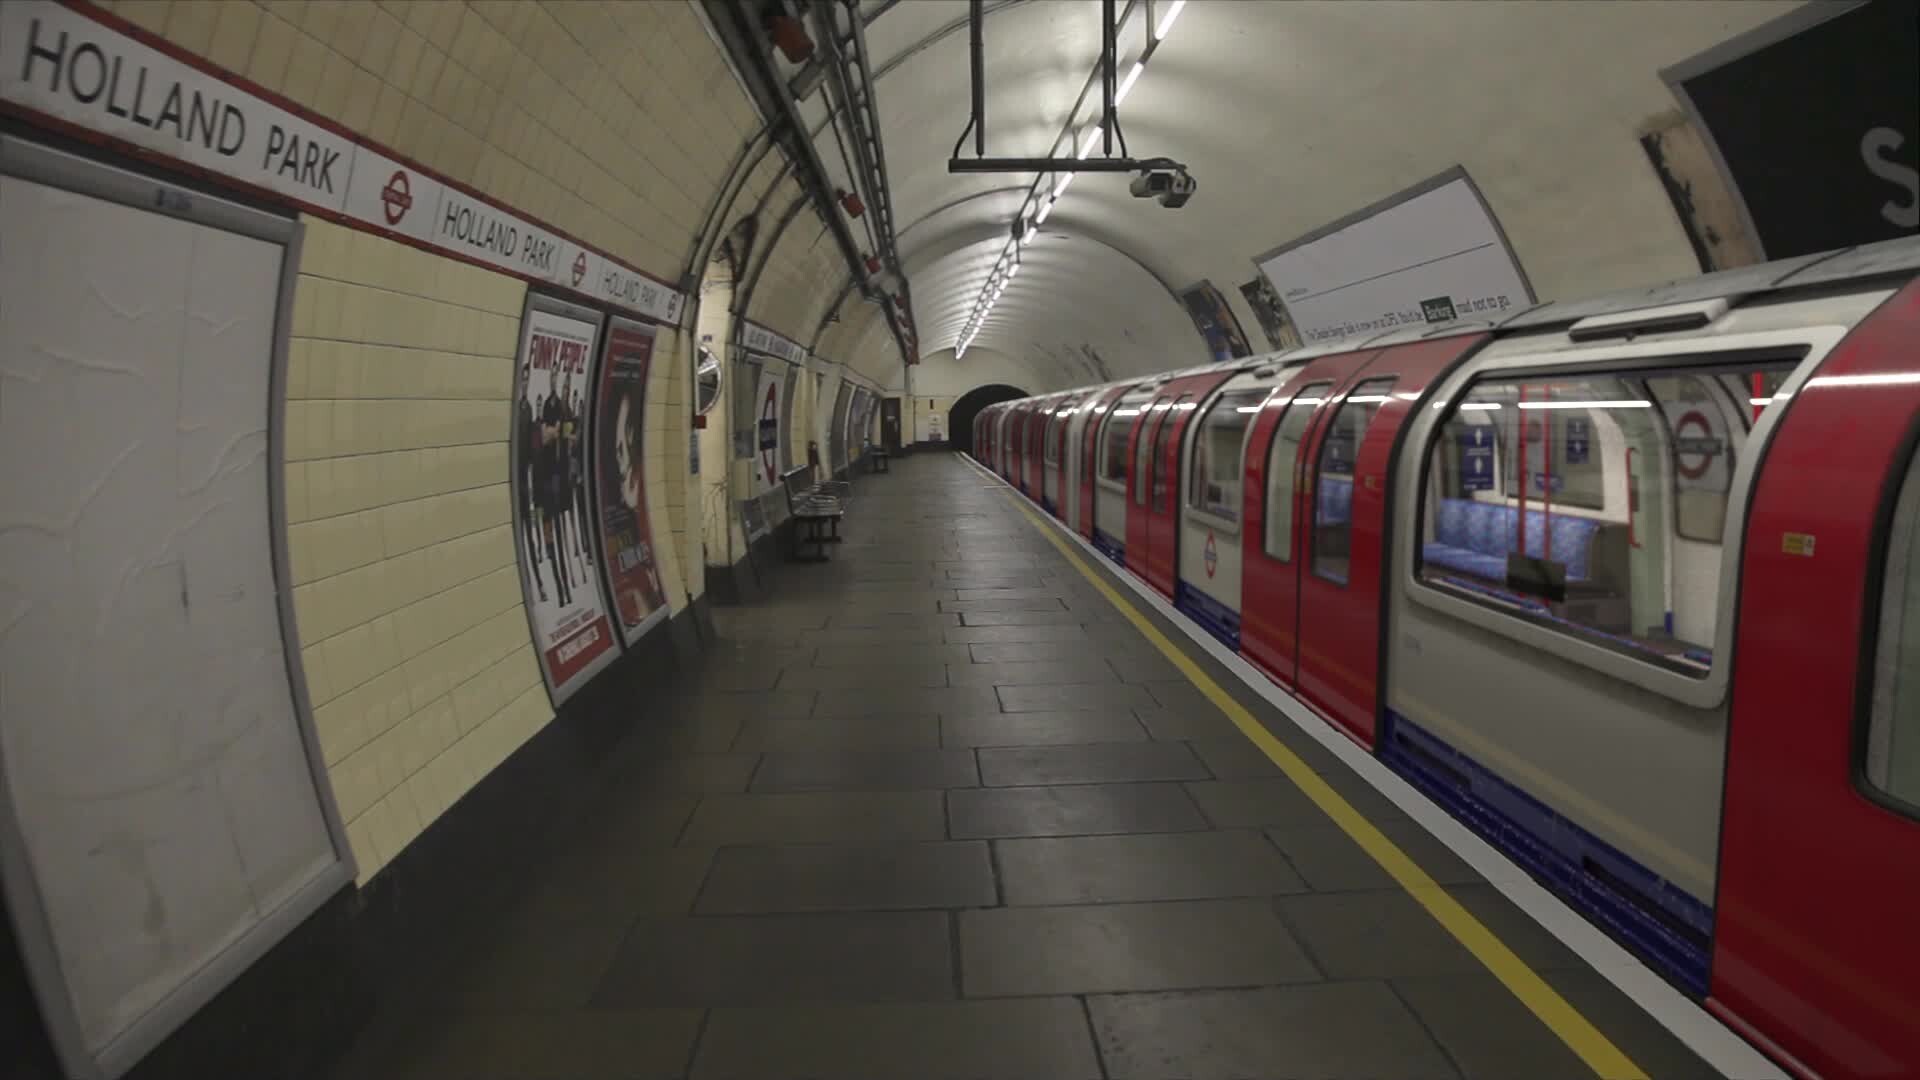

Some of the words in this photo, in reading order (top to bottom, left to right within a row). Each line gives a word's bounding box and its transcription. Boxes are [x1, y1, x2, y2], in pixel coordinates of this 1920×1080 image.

[20, 18, 247, 157] HOLLAND
[263, 124, 341, 195] PARK
[442, 201, 518, 258] HOLLAND
[521, 235, 556, 273] PARK
